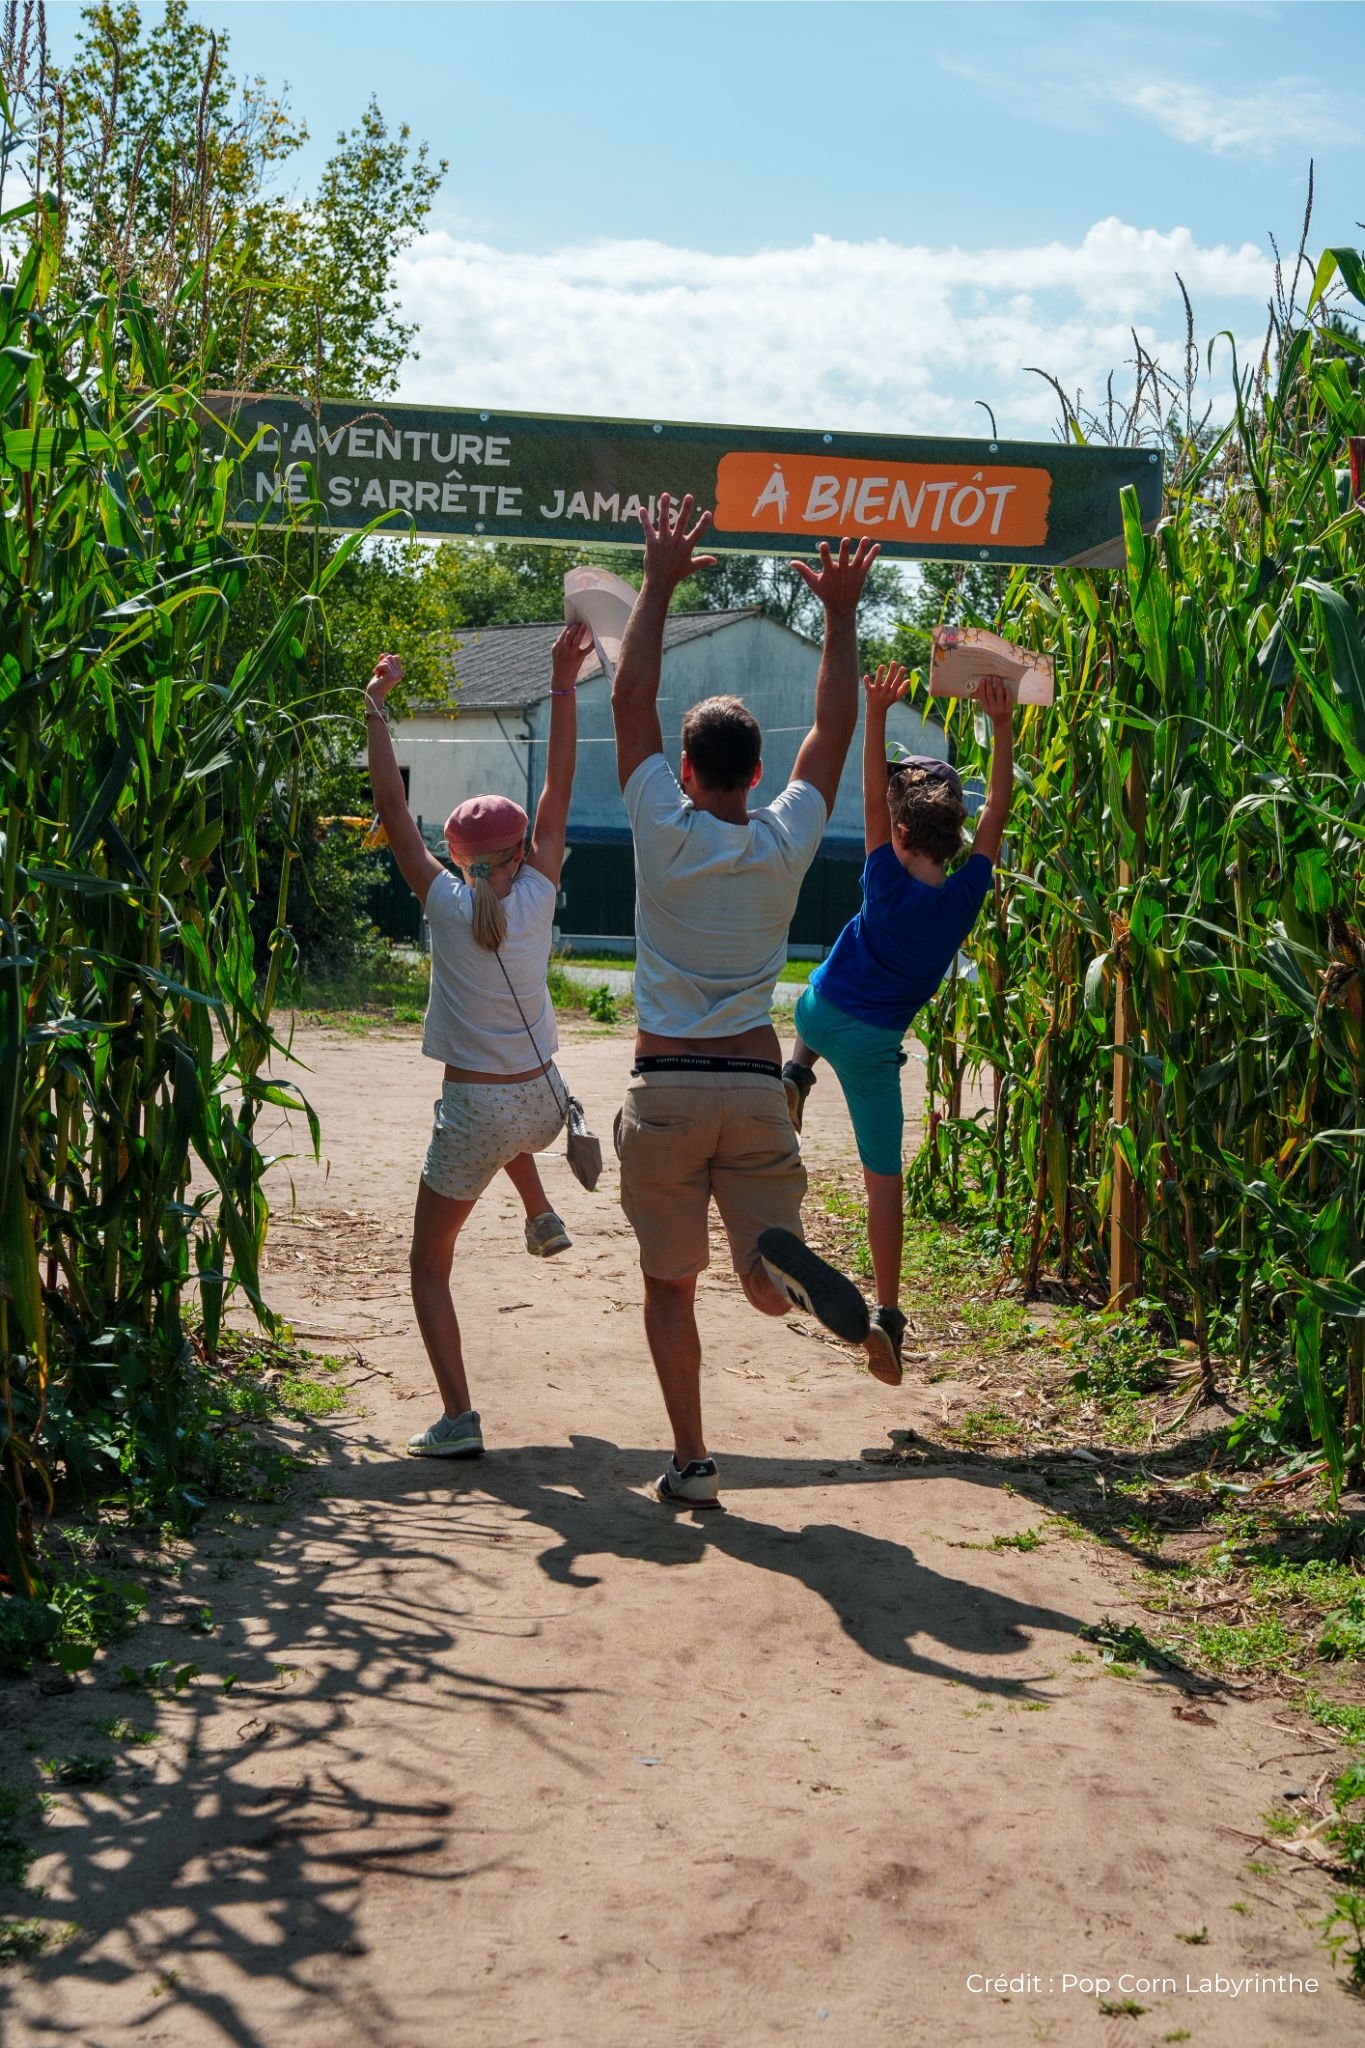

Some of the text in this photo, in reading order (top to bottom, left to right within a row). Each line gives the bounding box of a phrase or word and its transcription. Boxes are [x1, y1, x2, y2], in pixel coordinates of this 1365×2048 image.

[256, 421, 512, 467] L'AVENTURE
[256, 471, 312, 504] NE
[328, 469, 523, 517] S'ARRÊTE
[752, 463, 1016, 536] À BIENTÔT
